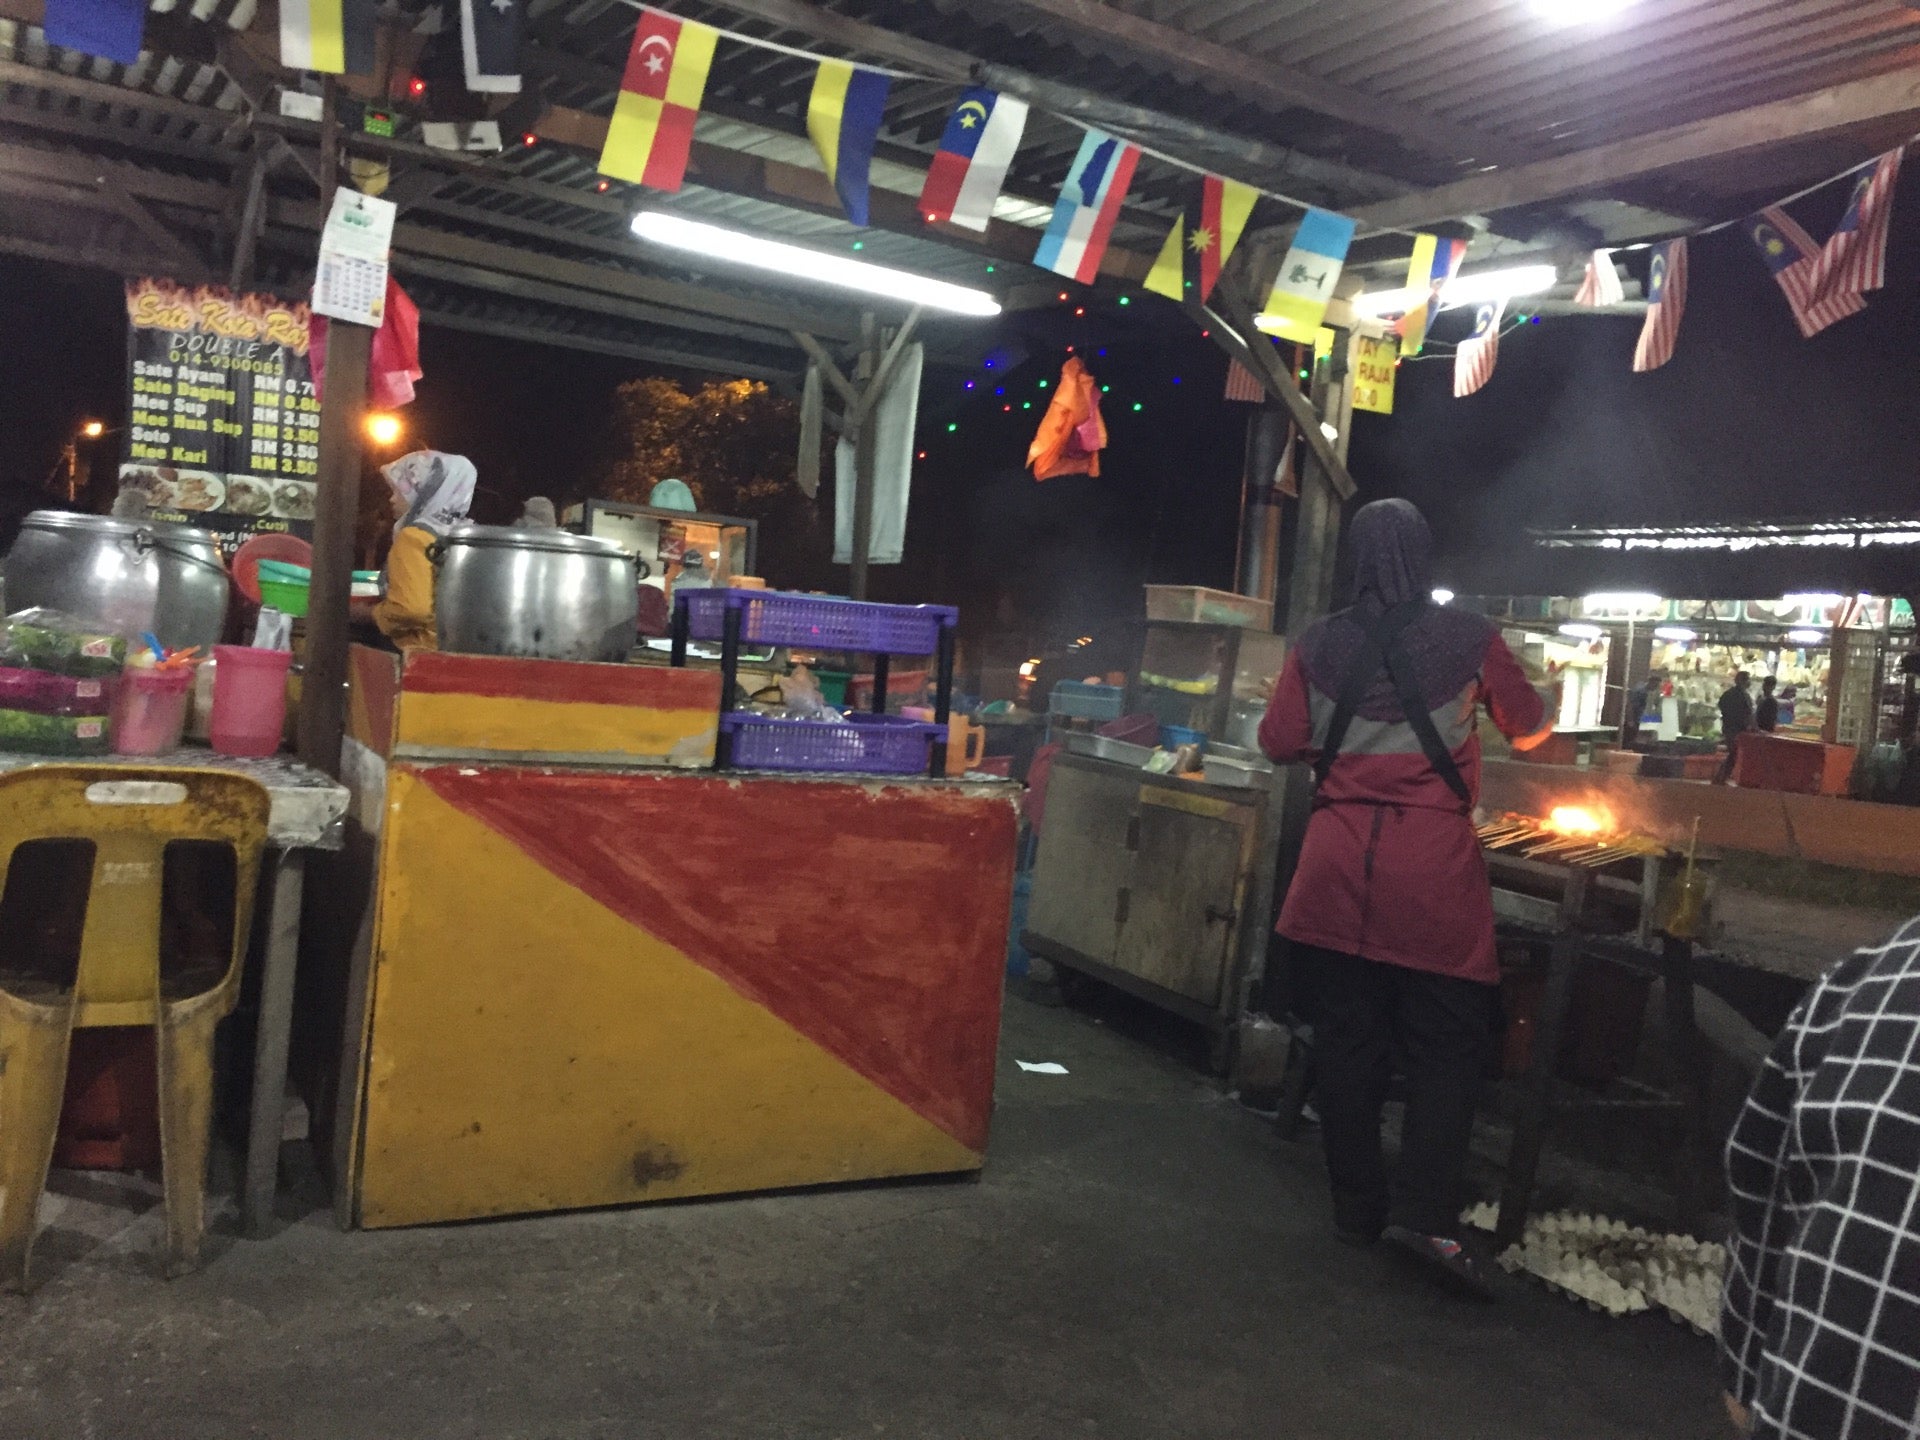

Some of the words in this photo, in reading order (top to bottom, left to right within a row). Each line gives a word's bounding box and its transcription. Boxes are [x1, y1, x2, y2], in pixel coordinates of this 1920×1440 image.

[169, 350, 284, 376] 014-9300085
[171, 333, 261, 360] DOUBLE
[269, 346, 284, 362] A
[133, 360, 174, 379] Sate
[177, 365, 226, 385] Ayam
[254, 374, 281, 392] RM
[133, 376, 172, 395] Sate
[177, 381, 236, 405] Daging
[253, 391, 280, 408] RM
[132, 393, 169, 411] Mee
[174, 397, 208, 418] Sup
[252, 407, 279, 424] RM
[283, 411, 321, 429] 3.50
[132, 410, 169, 428] Mee
[213, 418, 243, 438] Sup
[251, 423, 279, 440] RM
[282, 426, 320, 444] 3.50
[130, 443, 167, 460] Mee
[172, 446, 208, 464] Kari
[250, 455, 278, 472] RM
[281, 458, 318, 476] 3.50
[251, 439, 278, 456] RM
[282, 442, 319, 460] 3.50
